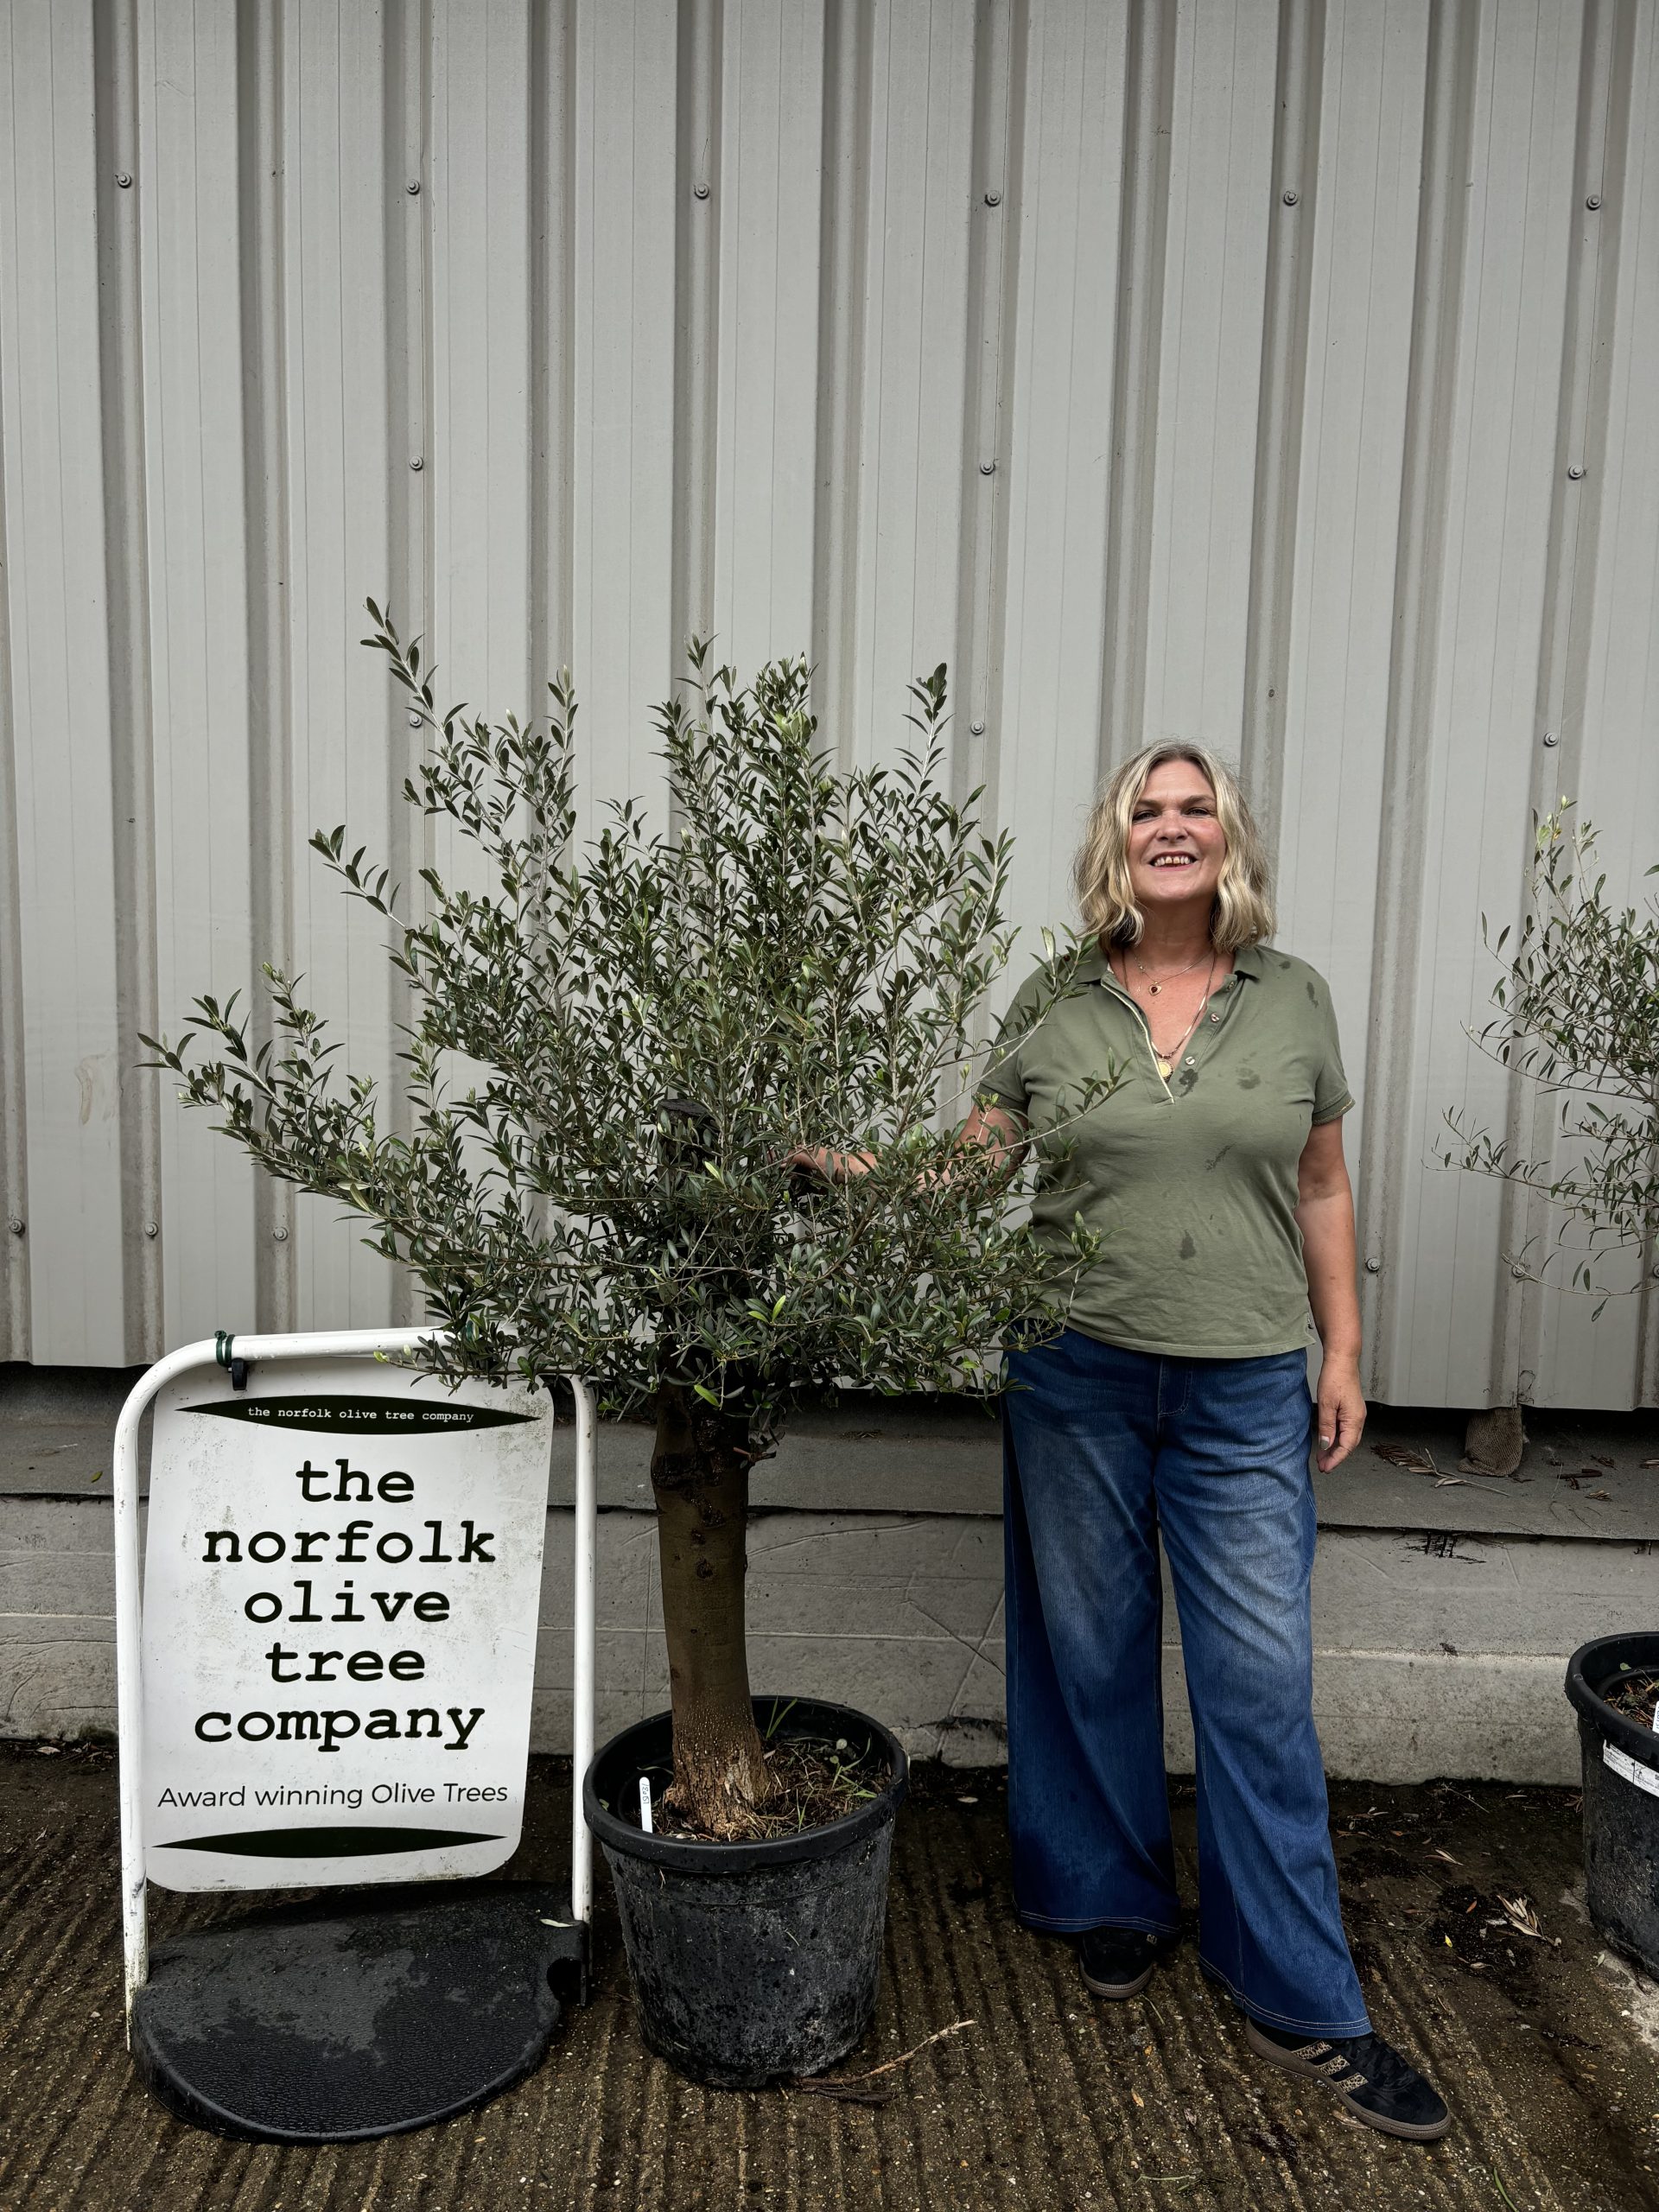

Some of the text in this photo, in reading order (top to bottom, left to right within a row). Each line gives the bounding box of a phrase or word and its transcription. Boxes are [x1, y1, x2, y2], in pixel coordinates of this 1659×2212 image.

[248, 1407, 474, 1423] the norfolk olive tree company
[296, 1459, 415, 1503] the
[201, 1520, 496, 1564] norfolk
[244, 1580, 450, 1624] olive
[264, 1642, 425, 1683] tree
[194, 1707, 486, 1752] company
[157, 1782, 508, 1809] Award winning Olive Trees
